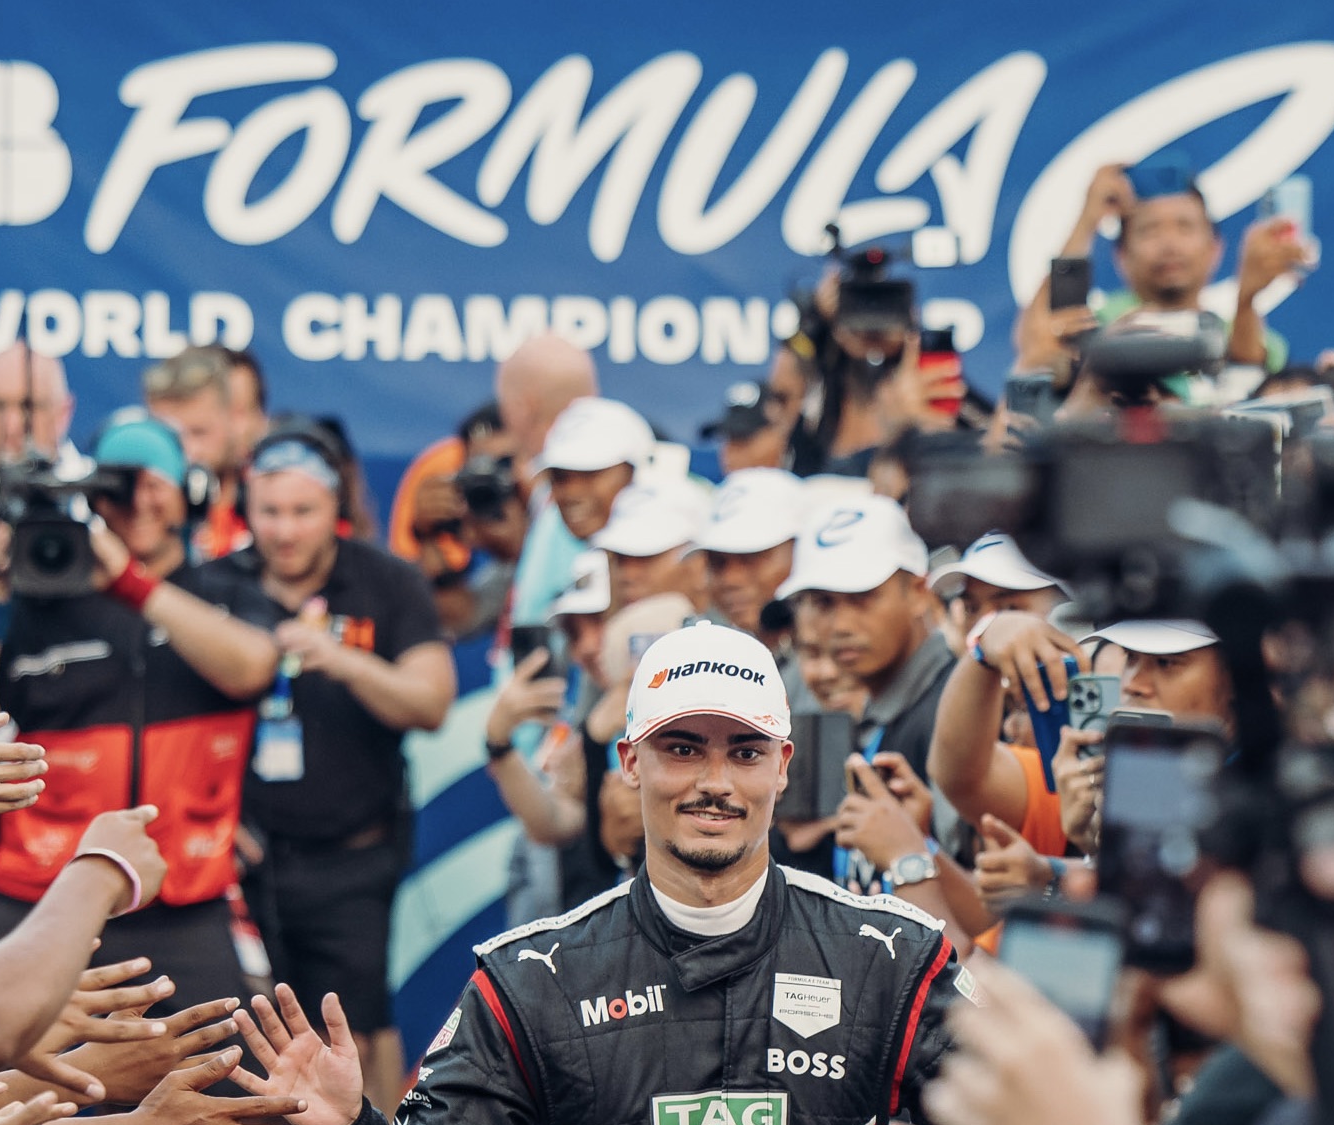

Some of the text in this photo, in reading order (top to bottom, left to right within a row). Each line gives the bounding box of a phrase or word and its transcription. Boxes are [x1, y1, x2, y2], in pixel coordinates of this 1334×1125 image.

[83, 42, 1049, 266] FORMULA
[580, 984, 664, 1027] Mobil
[779, 1008, 834, 1019] PORSCHE
[767, 1048, 846, 1080] BOSS
